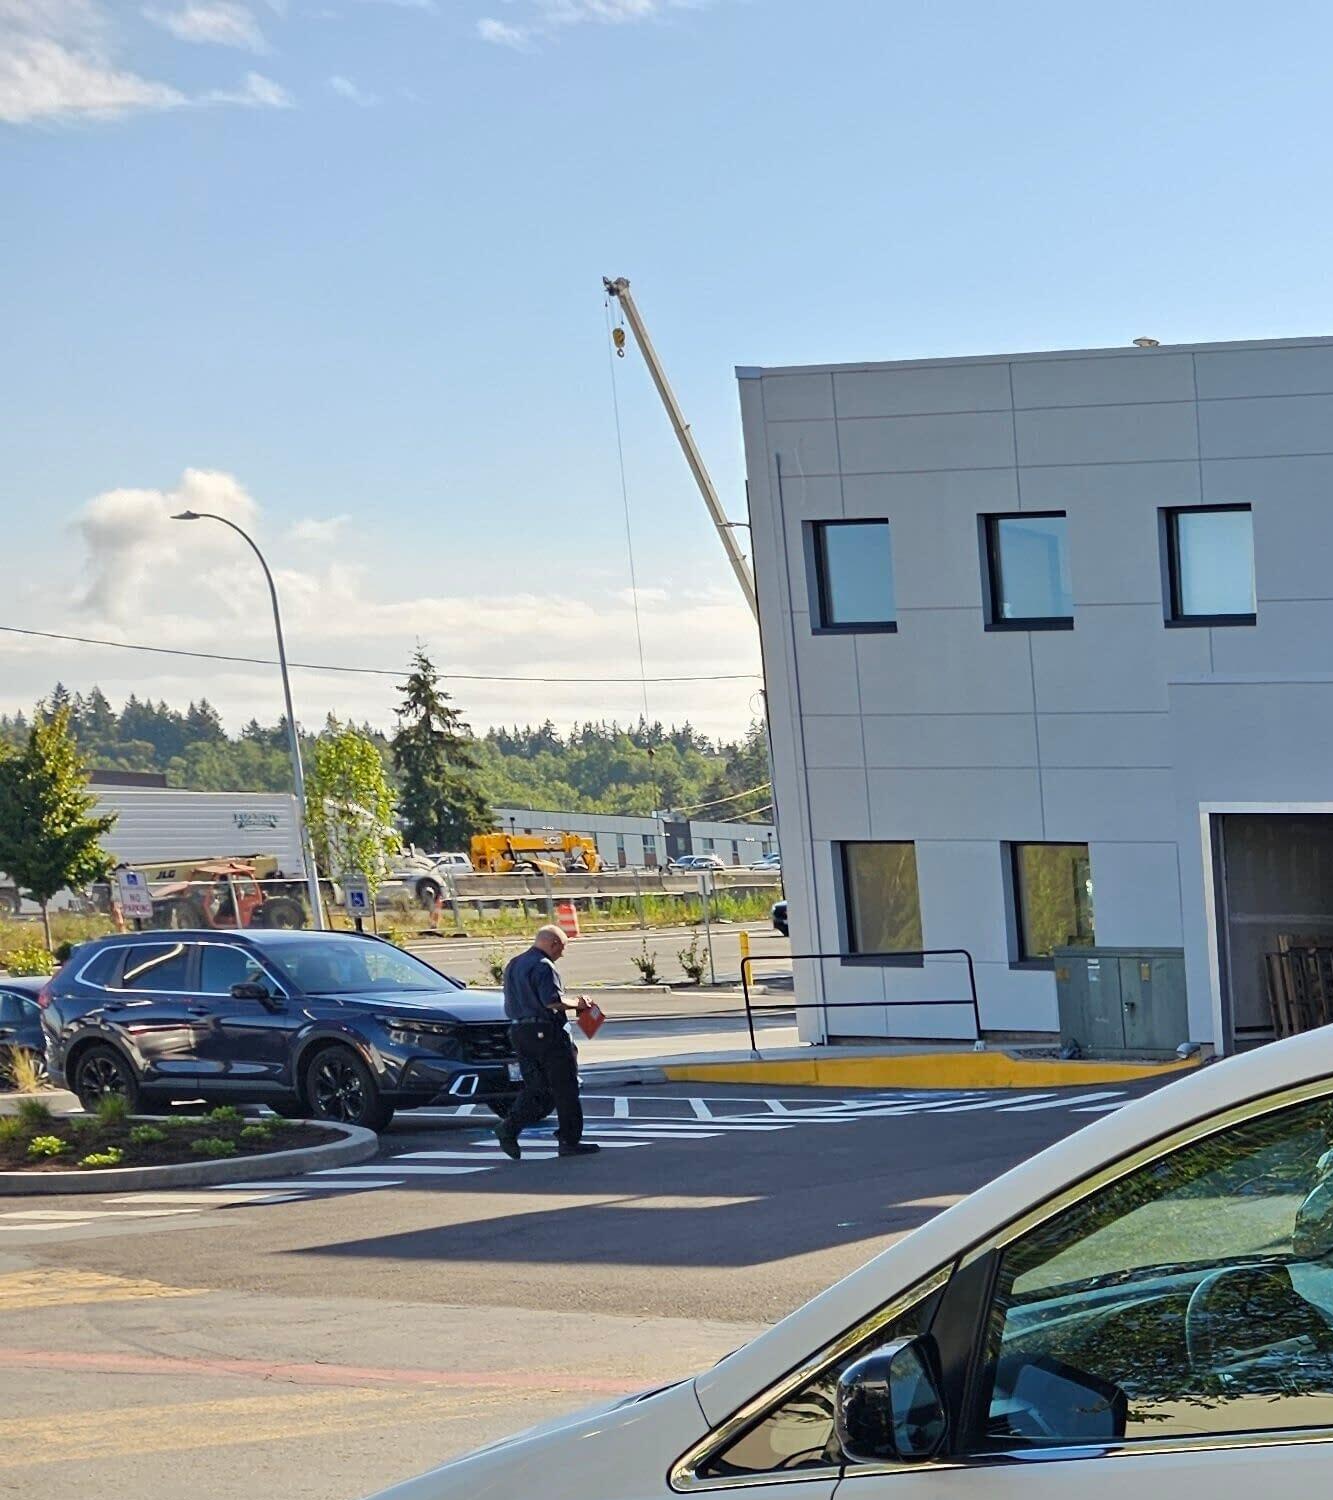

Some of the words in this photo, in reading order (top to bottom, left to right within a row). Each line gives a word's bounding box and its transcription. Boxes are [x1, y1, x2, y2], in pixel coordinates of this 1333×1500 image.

[544, 836, 562, 844] JCB
[156, 870, 176, 880] JLG
[129, 894, 141, 902] NO
[123, 903, 151, 912] PARKING
